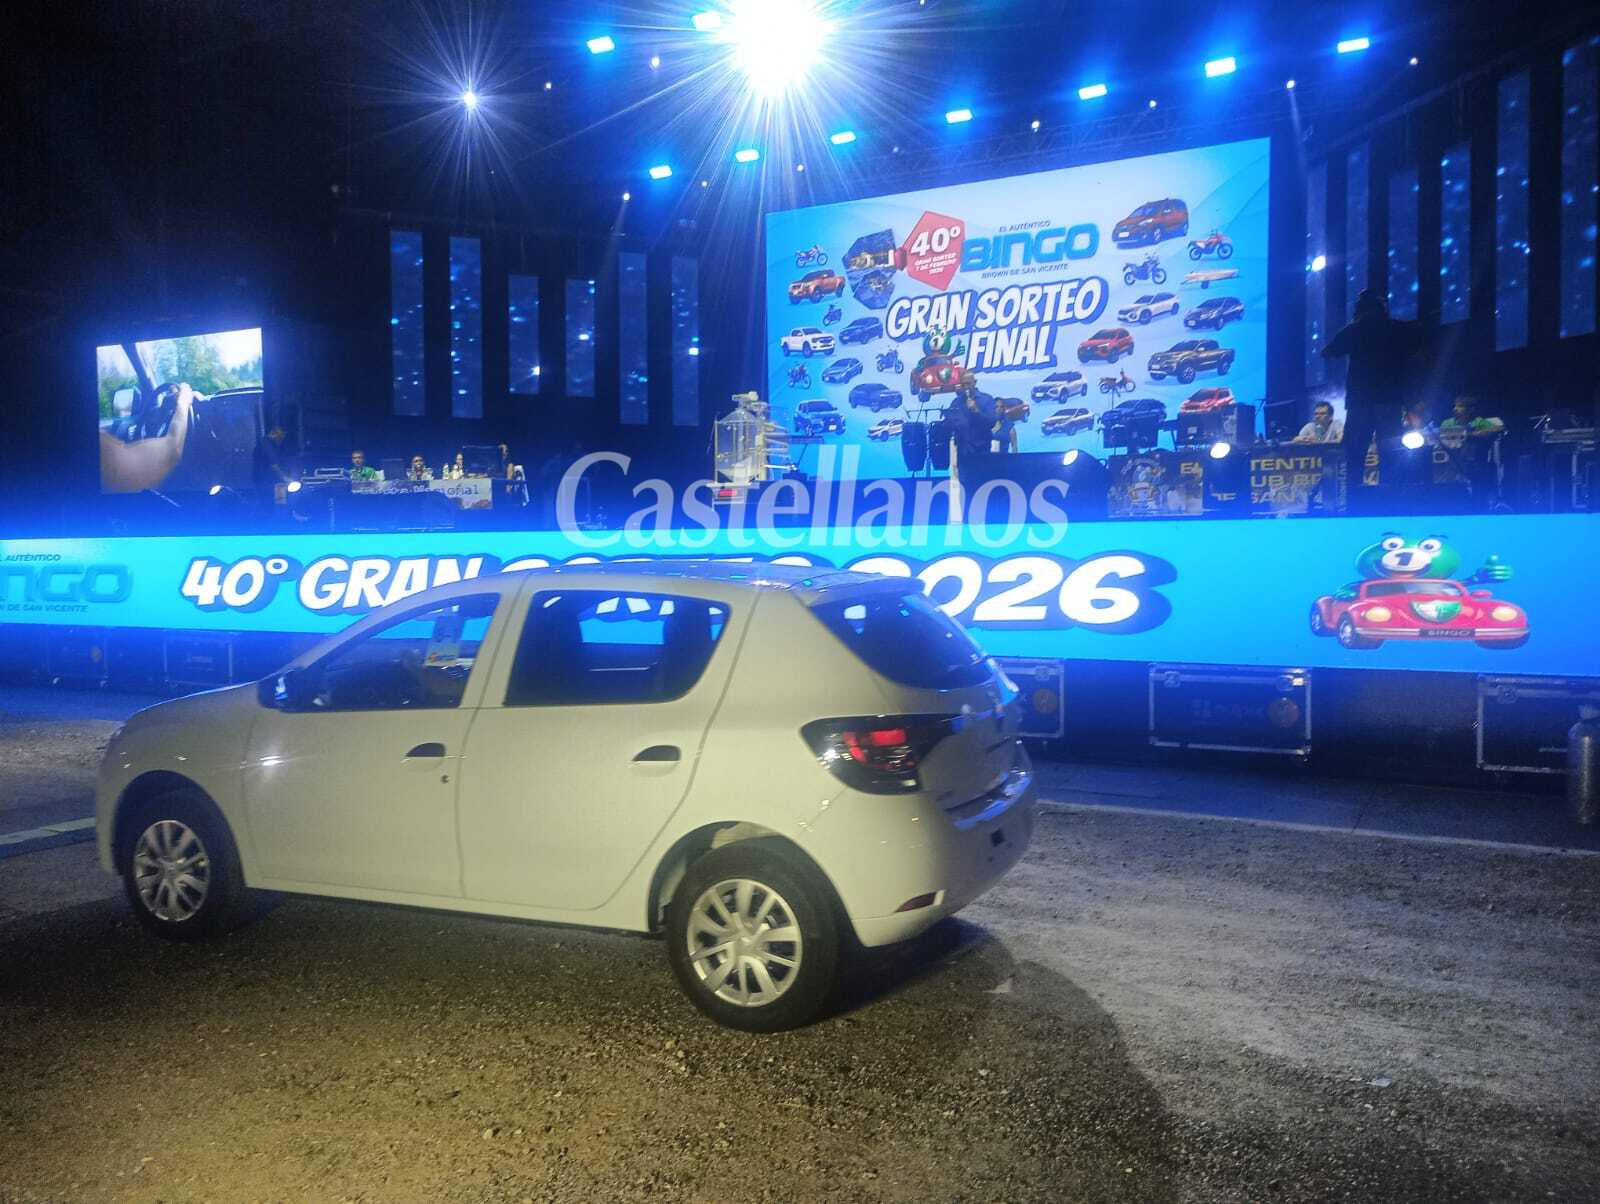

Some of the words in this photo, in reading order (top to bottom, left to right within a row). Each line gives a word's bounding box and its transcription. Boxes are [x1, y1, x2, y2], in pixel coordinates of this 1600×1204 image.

[960, 223, 1100, 273] BINGO
[887, 291, 972, 338] GRAN
[974, 278, 1103, 329] SORTEO
[967, 325, 1051, 369] FINAL
[181, 558, 290, 607] 40°
[1394, 551, 1415, 567] 1
